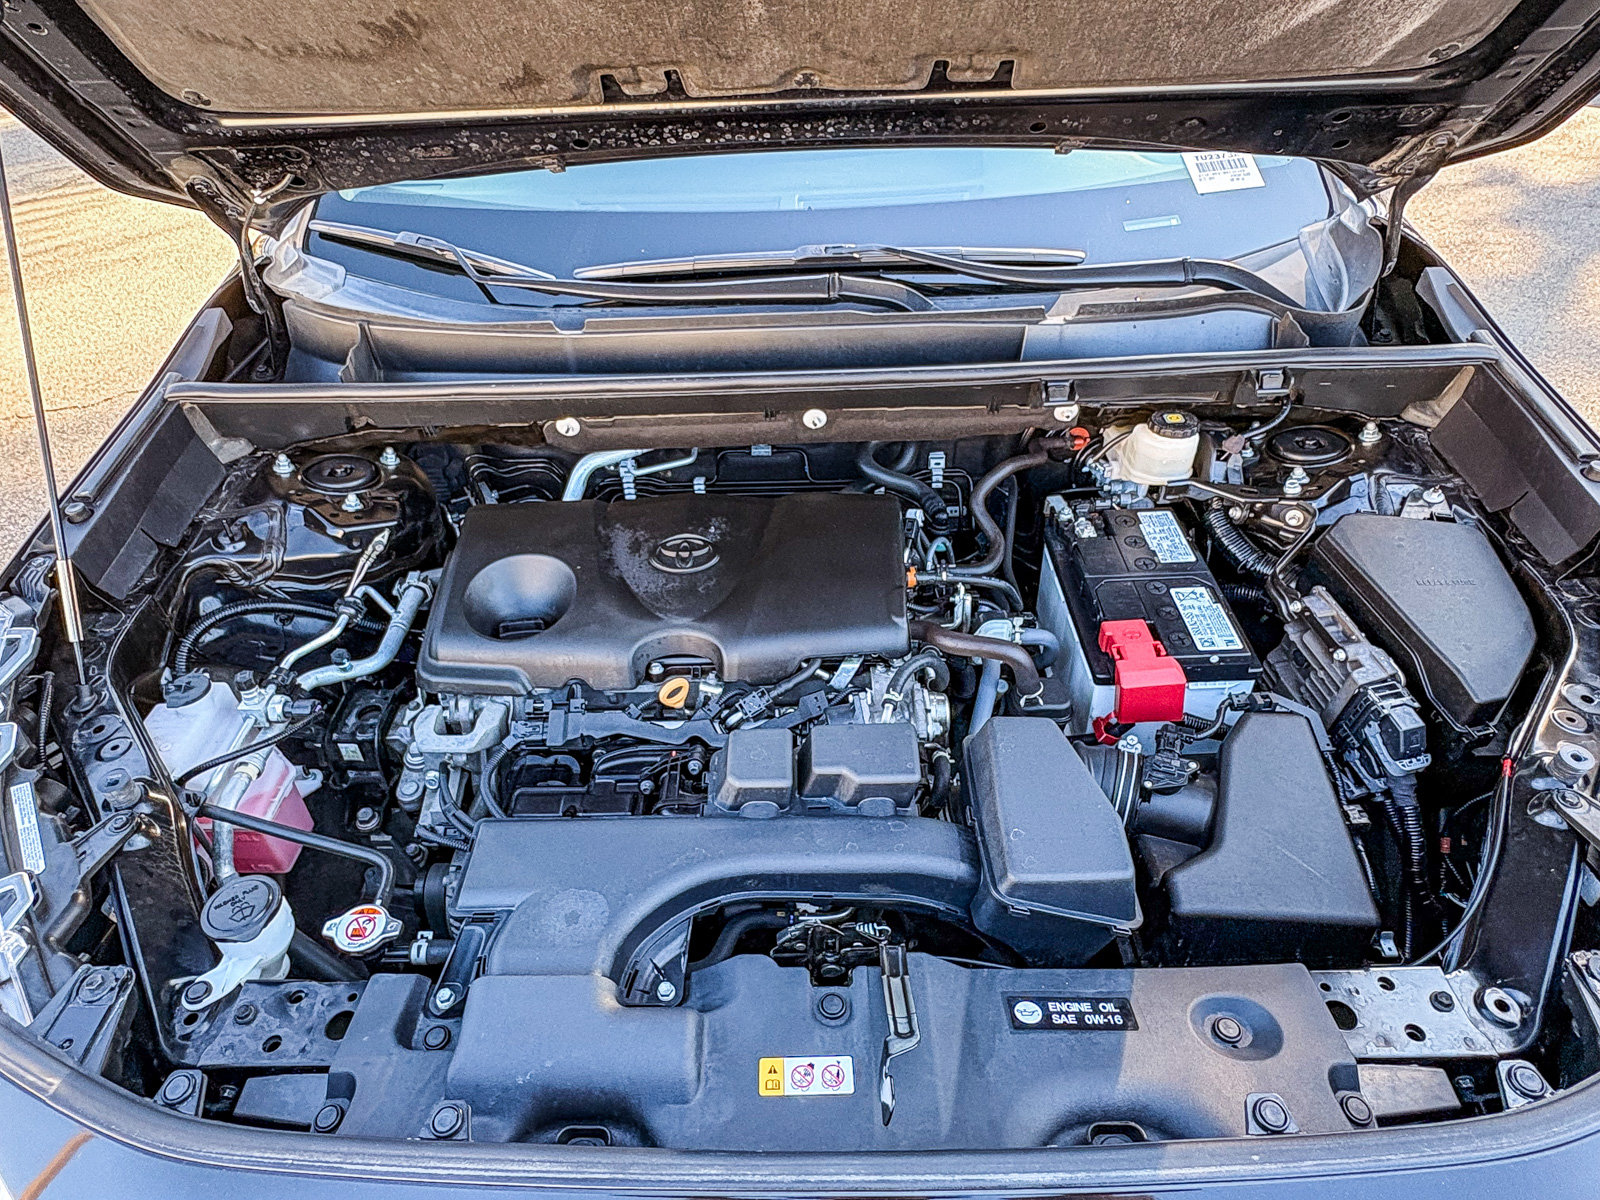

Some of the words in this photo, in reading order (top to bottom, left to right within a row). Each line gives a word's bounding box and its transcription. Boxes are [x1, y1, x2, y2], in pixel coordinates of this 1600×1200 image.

[1047, 1002, 1093, 1012] ENGINE
[1098, 1002, 1120, 1012] OIL
[1051, 1014, 1078, 1025] SAE
[1084, 1014, 1123, 1025] 0W-16
